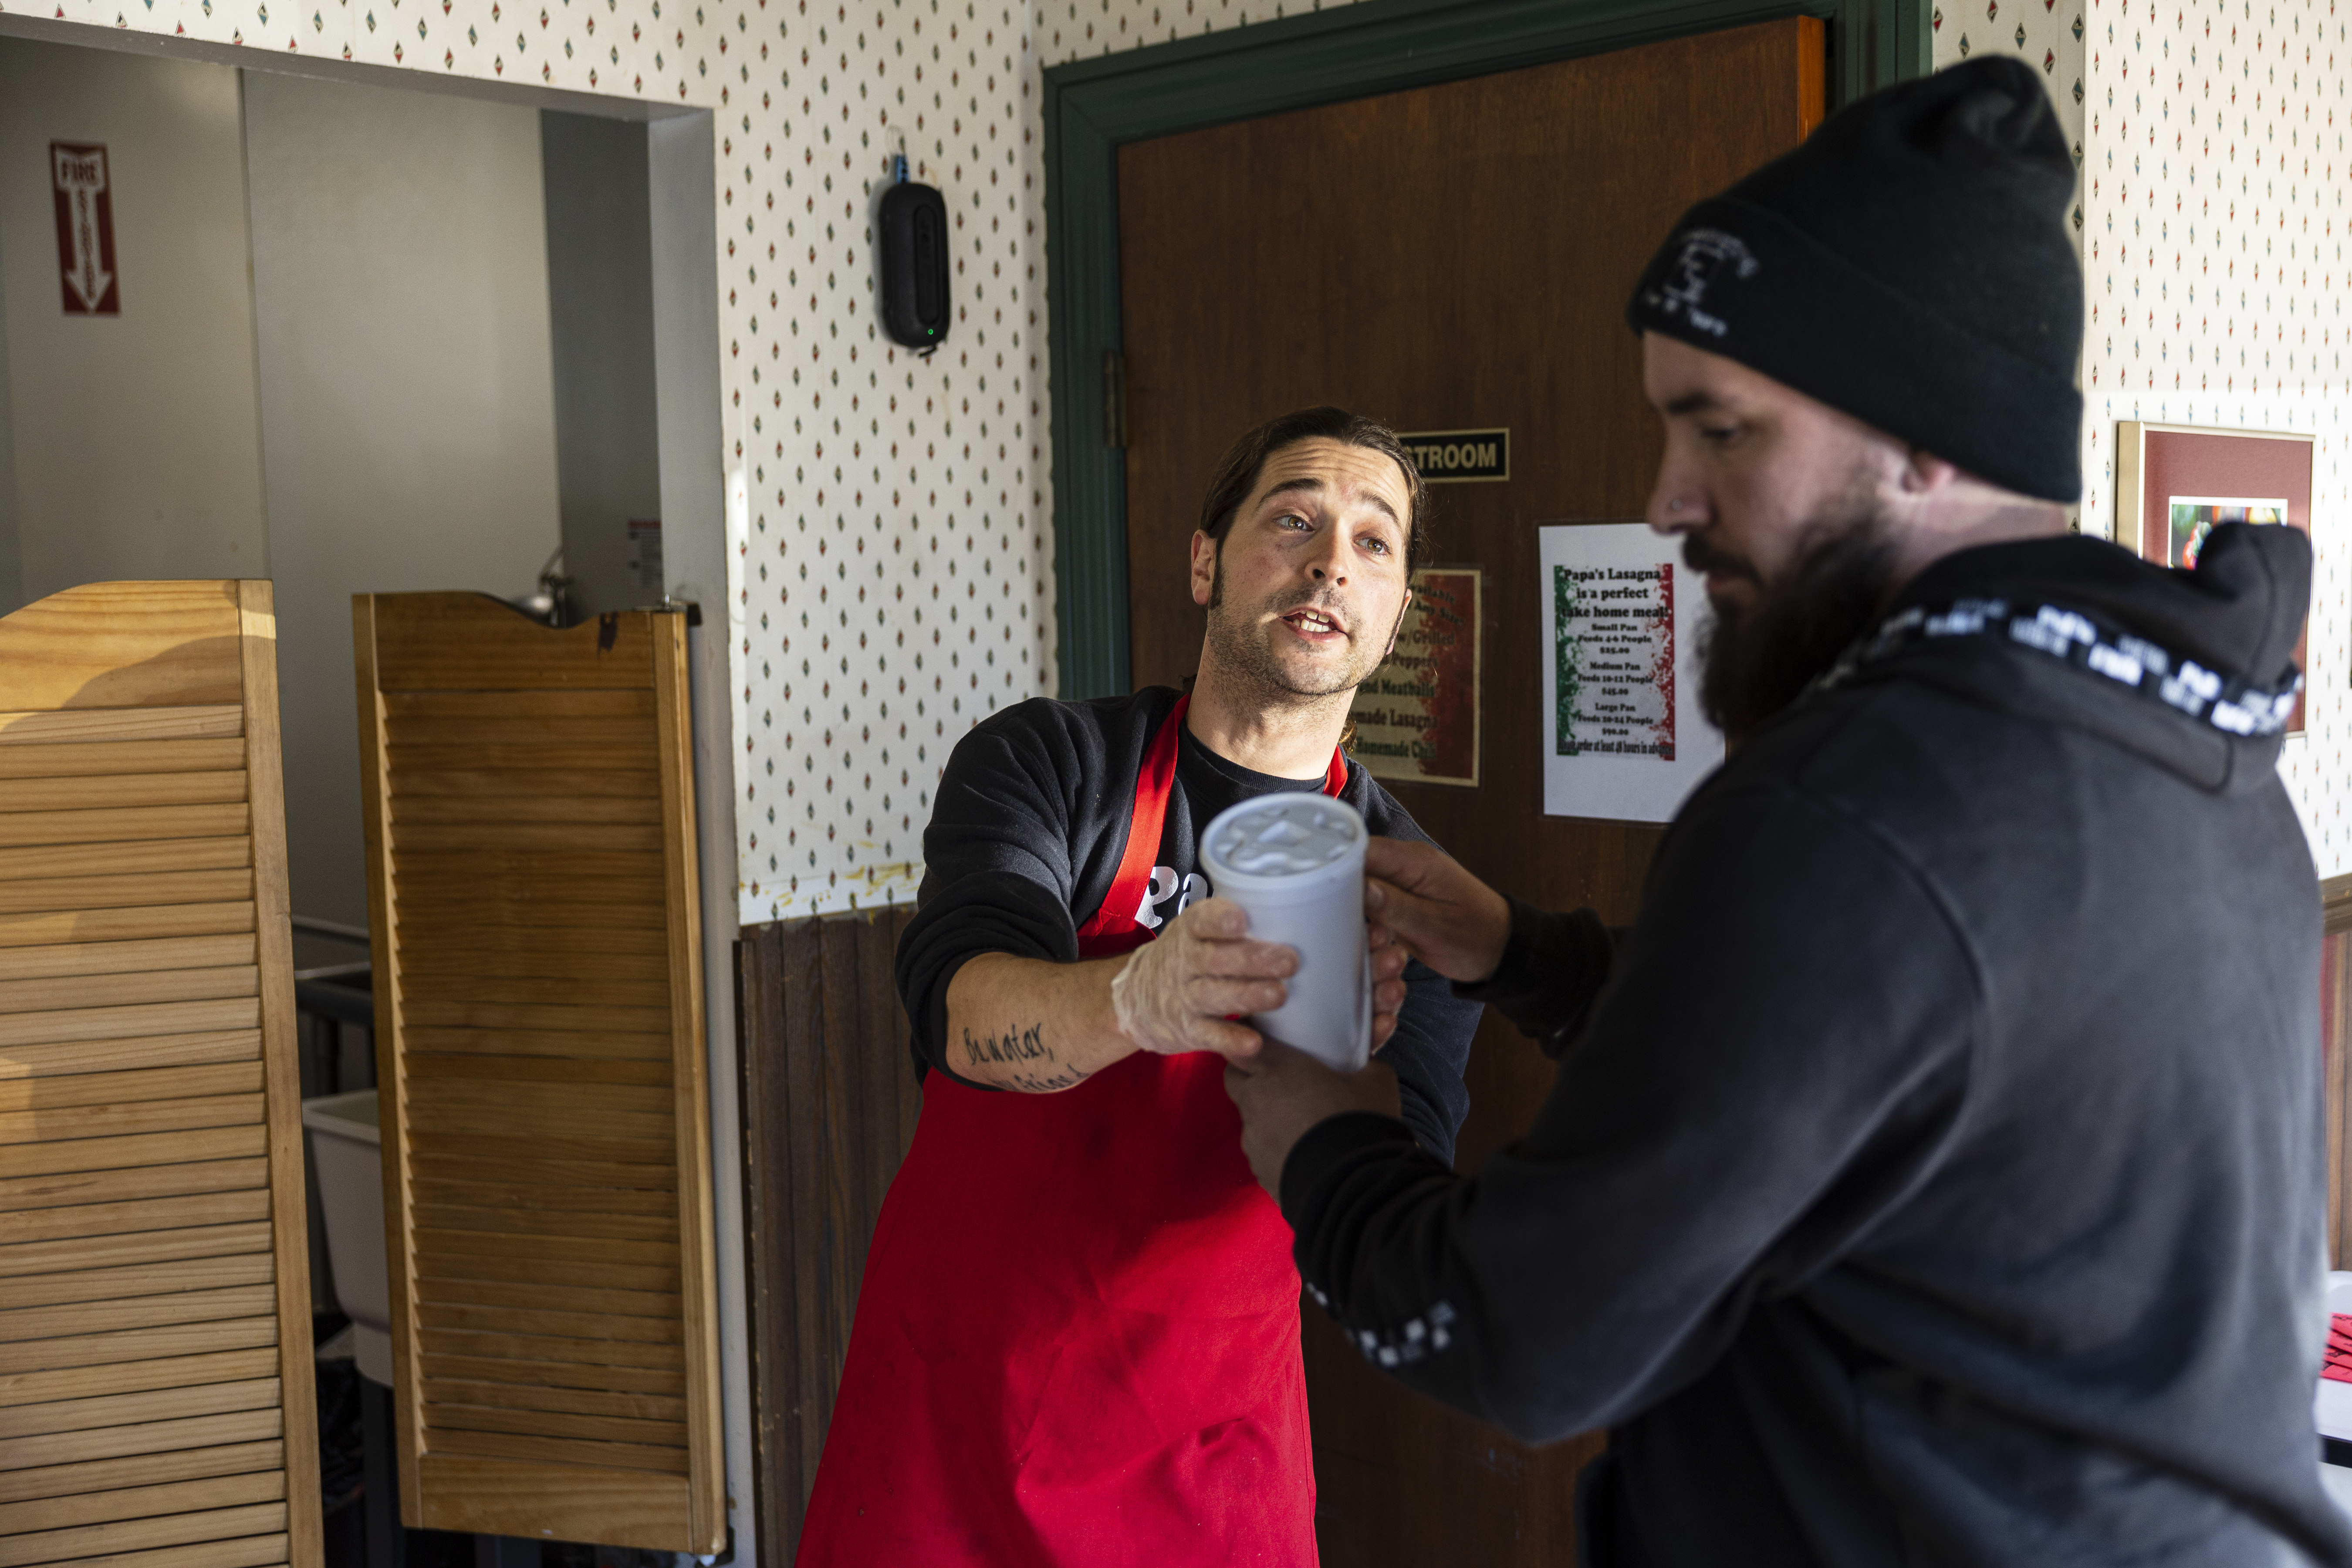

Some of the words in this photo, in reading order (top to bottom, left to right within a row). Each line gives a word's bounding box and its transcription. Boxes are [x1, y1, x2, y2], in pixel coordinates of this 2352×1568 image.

[61, 160, 98, 186] FIRE
[1403, 442, 1497, 470] TROOM
[1564, 568, 1604, 583] Papa's
[1608, 568, 1661, 583] Lasagna
[1409, 585, 1456, 604] vailable
[1576, 588, 1587, 599] is
[1591, 590, 1597, 599] a
[1601, 587, 1649, 601] perfect
[1414, 599, 1435, 615] Any
[1562, 606, 1590, 617] take
[1593, 606, 1629, 617] home
[1633, 606, 1669, 618] meal!
[1578, 634, 1603, 642] Feeds
[1621, 635, 1652, 644] People
[1590, 662, 1622, 670] Medium
[1625, 662, 1641, 671] Pan
[1578, 674, 1600, 682] Feeds
[1625, 675, 1653, 684] People
[1595, 703, 1618, 712] Large
[1620, 703, 1636, 712] Pan
[1578, 714, 1600, 723] Feeds
[1626, 715, 1653, 726] People
[1134, 866, 1208, 929] Pa
